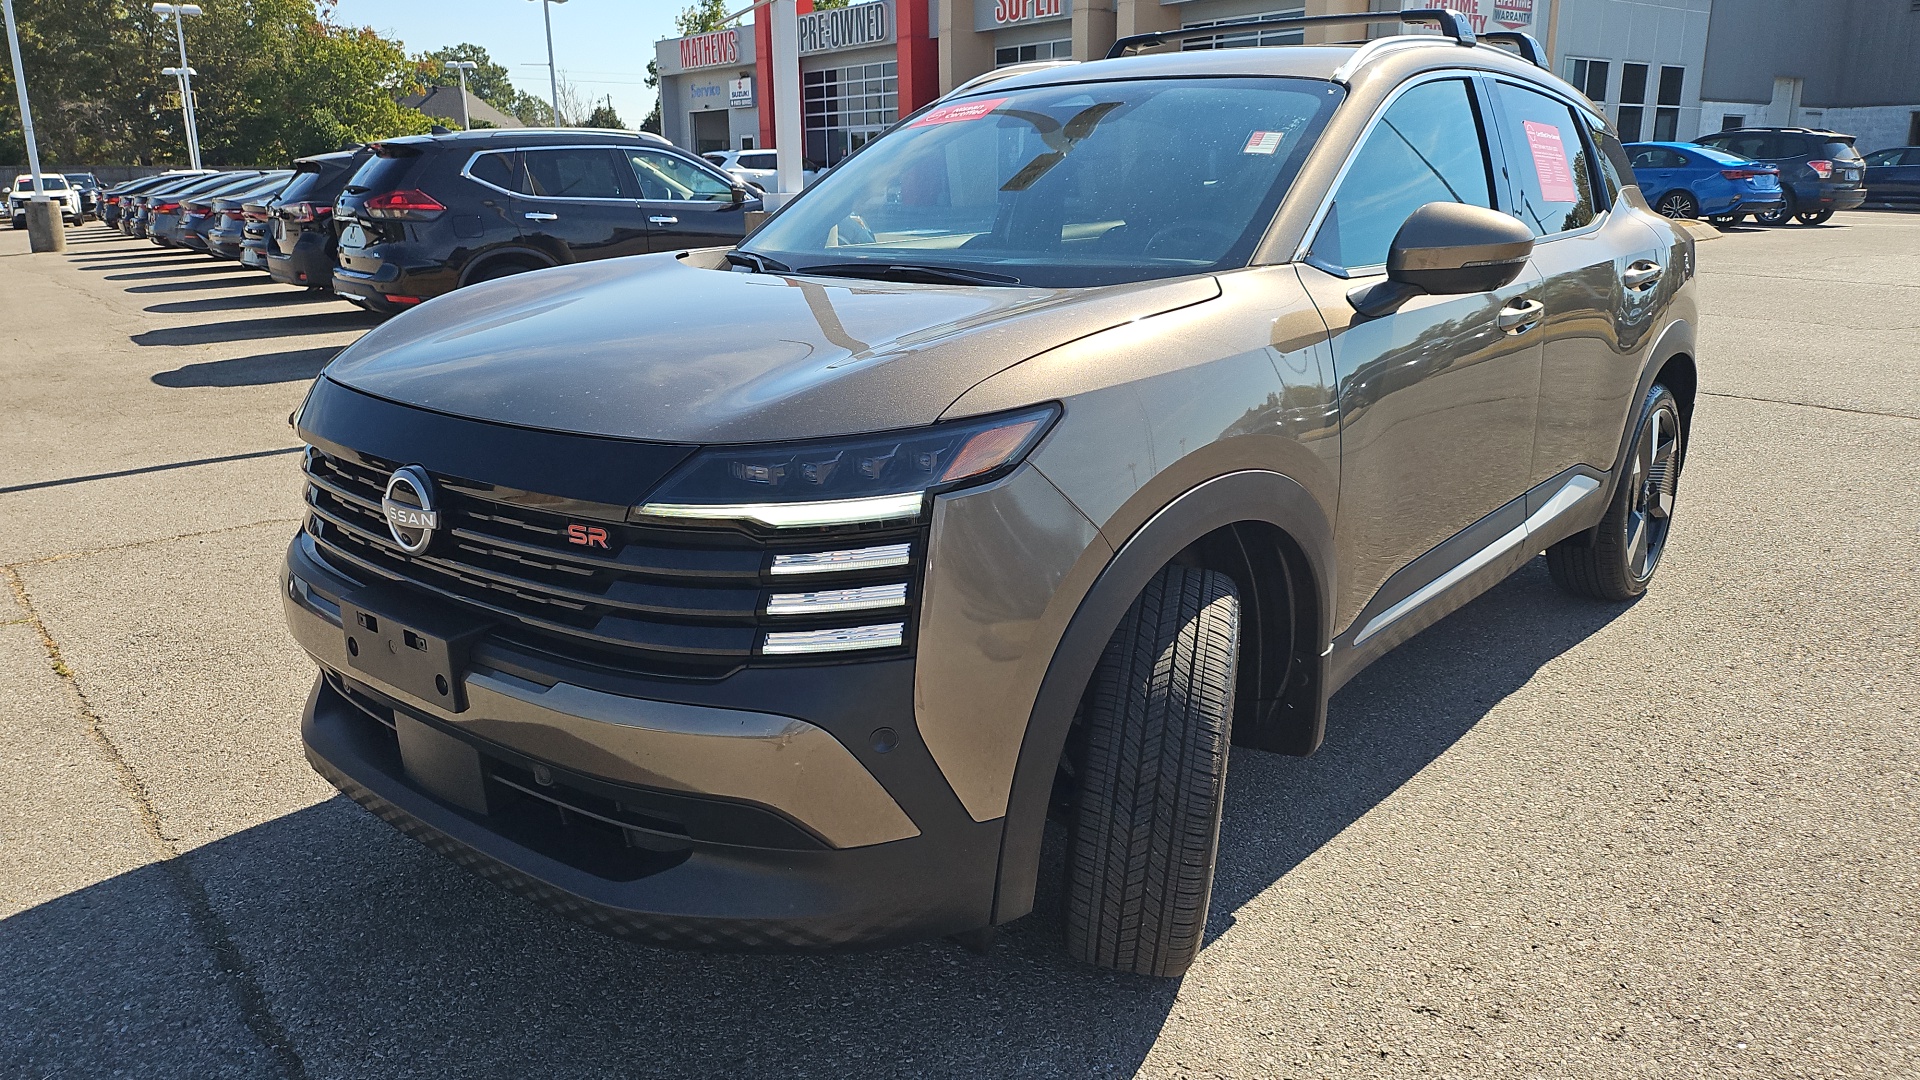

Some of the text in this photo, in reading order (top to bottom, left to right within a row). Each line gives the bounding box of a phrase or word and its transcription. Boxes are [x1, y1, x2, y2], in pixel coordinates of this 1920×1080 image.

[1424, 0, 1479, 14] IFETIME
[1494, 9, 1531, 24] WARRANTY
[799, 4, 885, 52] PRE-OWNED
[679, 30, 736, 69] MATHEWS
[690, 83, 720, 98] Service
[731, 90, 750, 98] SUZUKI
[567, 524, 609, 549] SR
